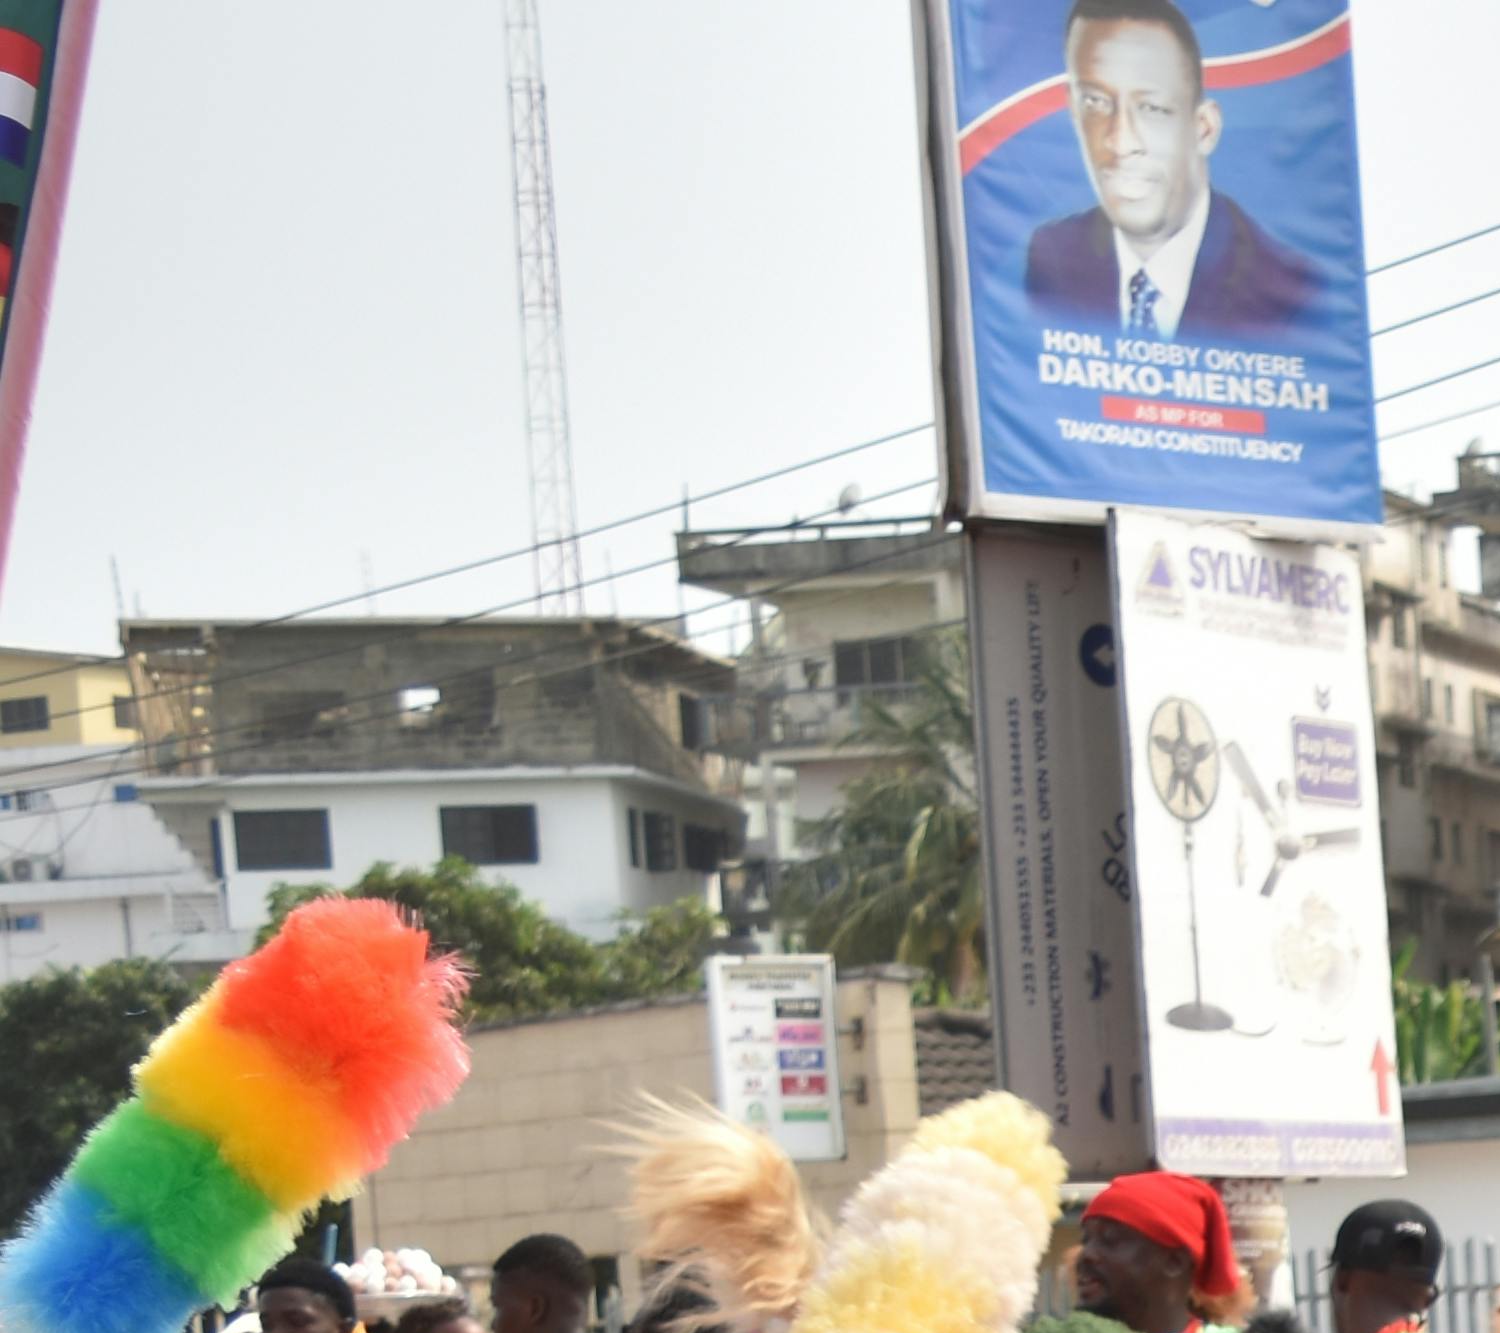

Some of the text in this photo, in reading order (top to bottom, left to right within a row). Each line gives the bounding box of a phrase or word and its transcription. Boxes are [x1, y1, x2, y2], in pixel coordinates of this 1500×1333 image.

[1042, 329, 1305, 379] HON. KOBBY OKYERE
[1038, 353, 1329, 412] DARKO-MENSAH
[1056, 417, 1154, 447] TAKORADI
[1188, 409, 1223, 428] FOR
[1027, 622, 1047, 704] QUALITY
[1031, 710, 1047, 763] YOUR
[1036, 768, 1051, 821] OPEN
[1047, 945, 1068, 1098] CONSTRUCTION
